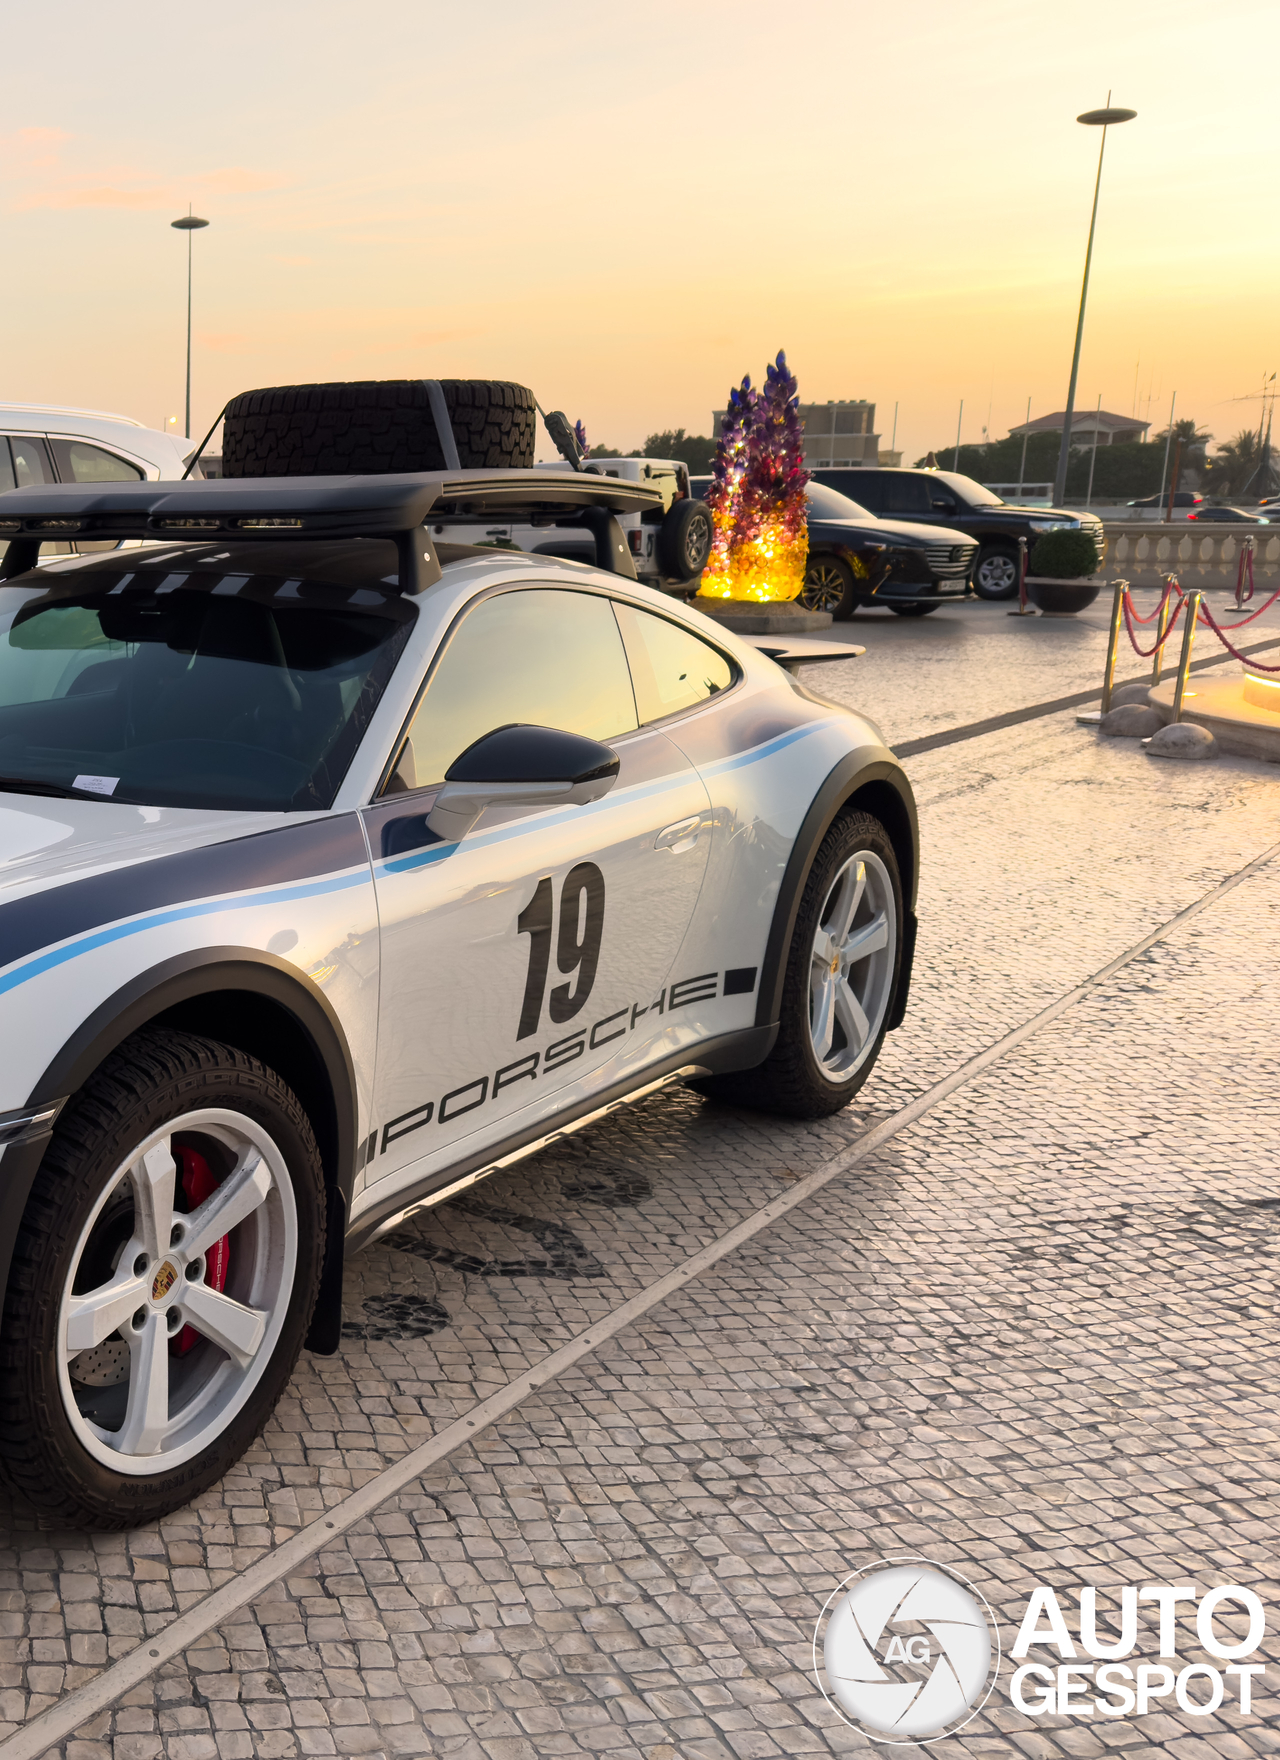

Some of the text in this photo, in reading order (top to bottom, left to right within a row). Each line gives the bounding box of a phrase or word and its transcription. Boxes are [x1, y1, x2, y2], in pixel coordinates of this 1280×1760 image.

[516, 861, 606, 1042] 19
[380, 972, 718, 1156] PORSCHE
[215, 1236, 224, 1292] ORSCHE
